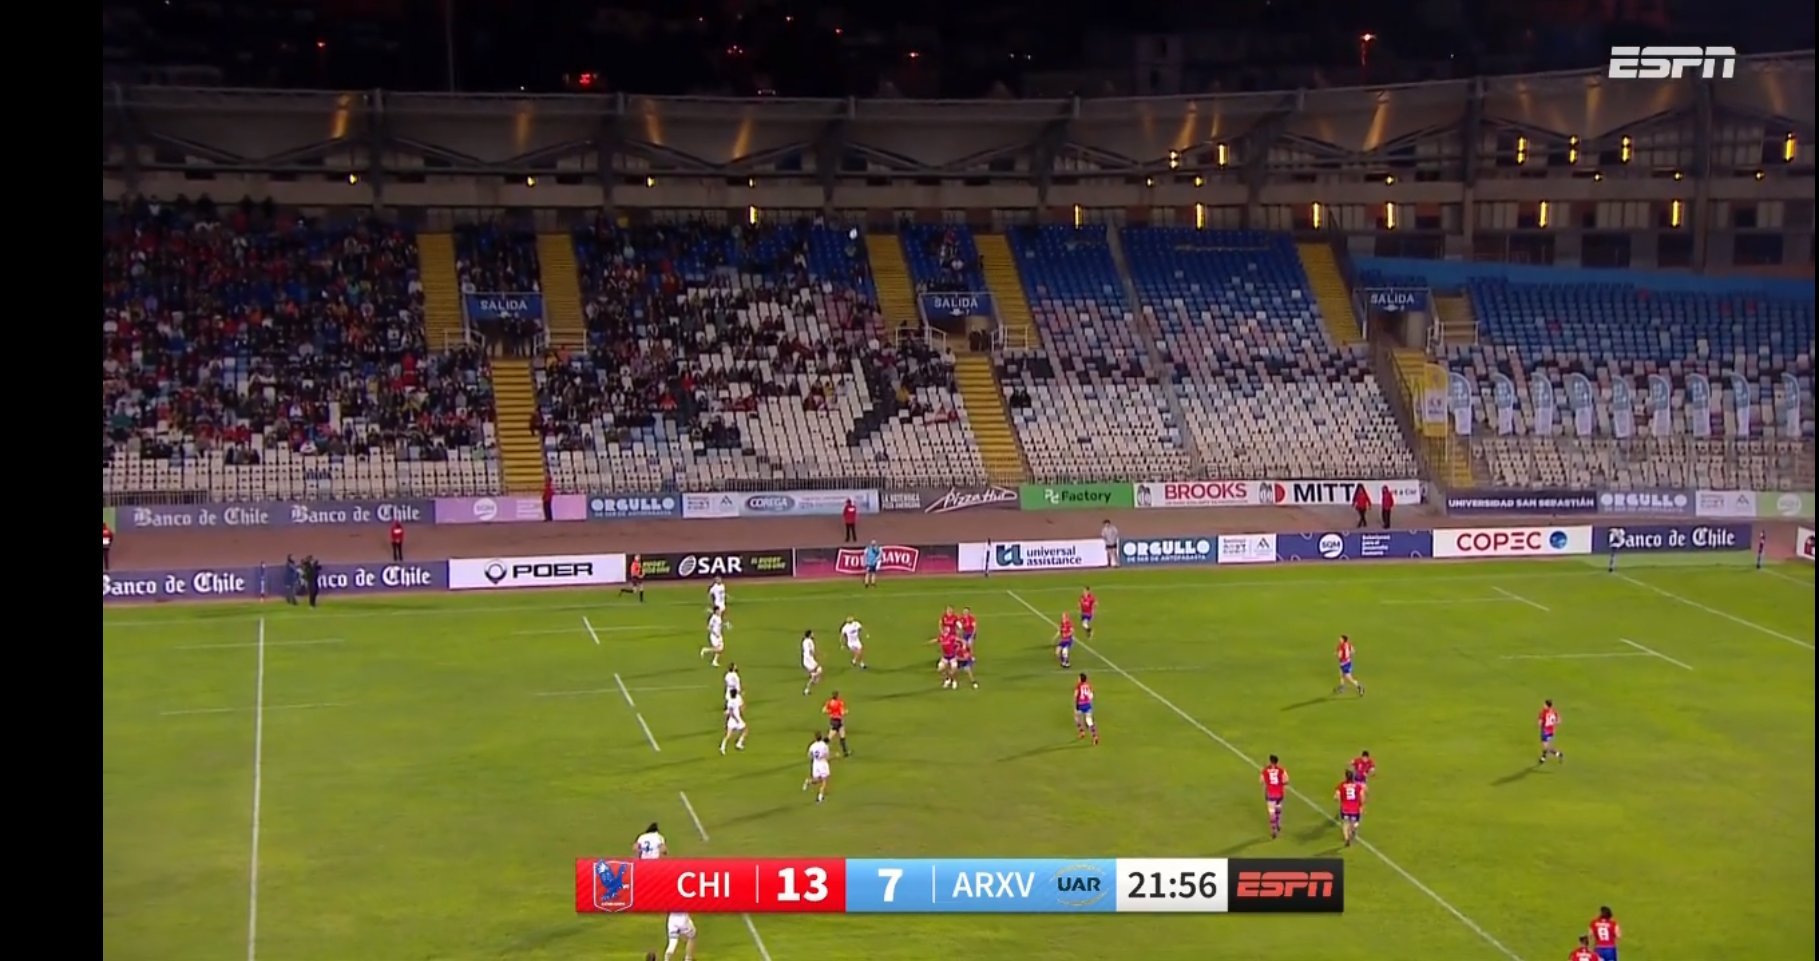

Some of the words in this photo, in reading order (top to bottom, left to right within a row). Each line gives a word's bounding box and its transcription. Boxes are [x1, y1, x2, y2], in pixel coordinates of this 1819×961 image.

[480, 299, 527, 311] SALIDA
[934, 297, 978, 308] SALIDA
[1370, 292, 1415, 304] SALIDA
[1061, 490, 1112, 504] Factory
[1165, 482, 1248, 500] BROOKS
[591, 497, 675, 512] ORGULLO
[1516, 498, 1537, 508] SAN
[1601, 493, 1687, 508] ORGULLO
[134, 507, 191, 527] Banco
[199, 507, 216, 525] de
[224, 507, 269, 526] Chile
[291, 504, 346, 523] Banco
[353, 505, 370, 522] de
[377, 504, 420, 522] Chile
[1457, 531, 1541, 551] COPEC
[1609, 528, 1662, 548] Banco
[1669, 528, 1686, 547] de
[1692, 527, 1736, 547] Chile
[1026, 545, 1076, 557] universal
[1123, 539, 1210, 556] ORGULLO
[698, 556, 742, 574] SAR
[1026, 556, 1082, 566] assistance
[317, 568, 348, 588] nco
[355, 568, 375, 586] de
[382, 566, 431, 587] Chile
[513, 562, 594, 578] POER
[165, 575, 186, 593] de
[194, 571, 245, 593] Chile
